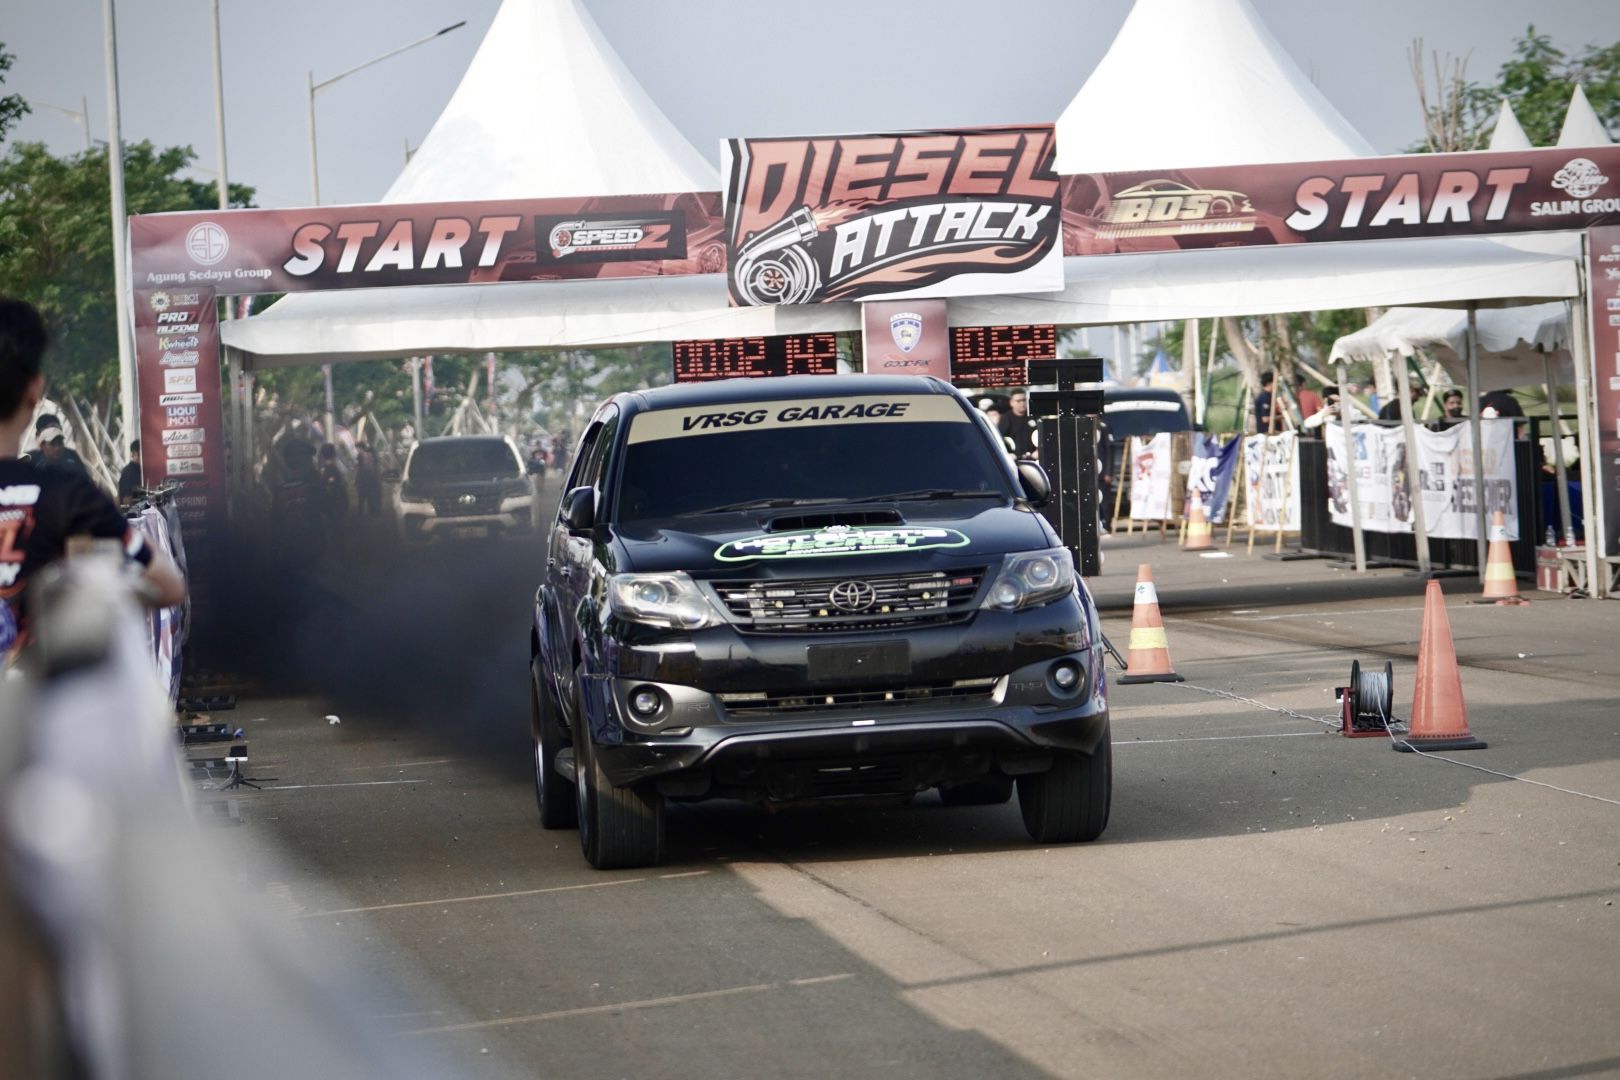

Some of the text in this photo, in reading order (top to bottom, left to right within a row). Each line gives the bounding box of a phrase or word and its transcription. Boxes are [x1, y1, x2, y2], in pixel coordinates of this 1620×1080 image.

[739, 133, 1061, 242] DIESEL
[1286, 168, 1533, 232] START
[1530, 201, 1580, 217] SALIM
[283, 216, 521, 276] START
[829, 202, 1052, 278] ATTACK
[147, 268, 272, 283] Agung Sedayu Group
[169, 407, 196, 416] LIQUI
[169, 416, 197, 425] MOLY
[682, 403, 910, 431] VRSG GARAGE
[734, 535, 810, 550] HOT
